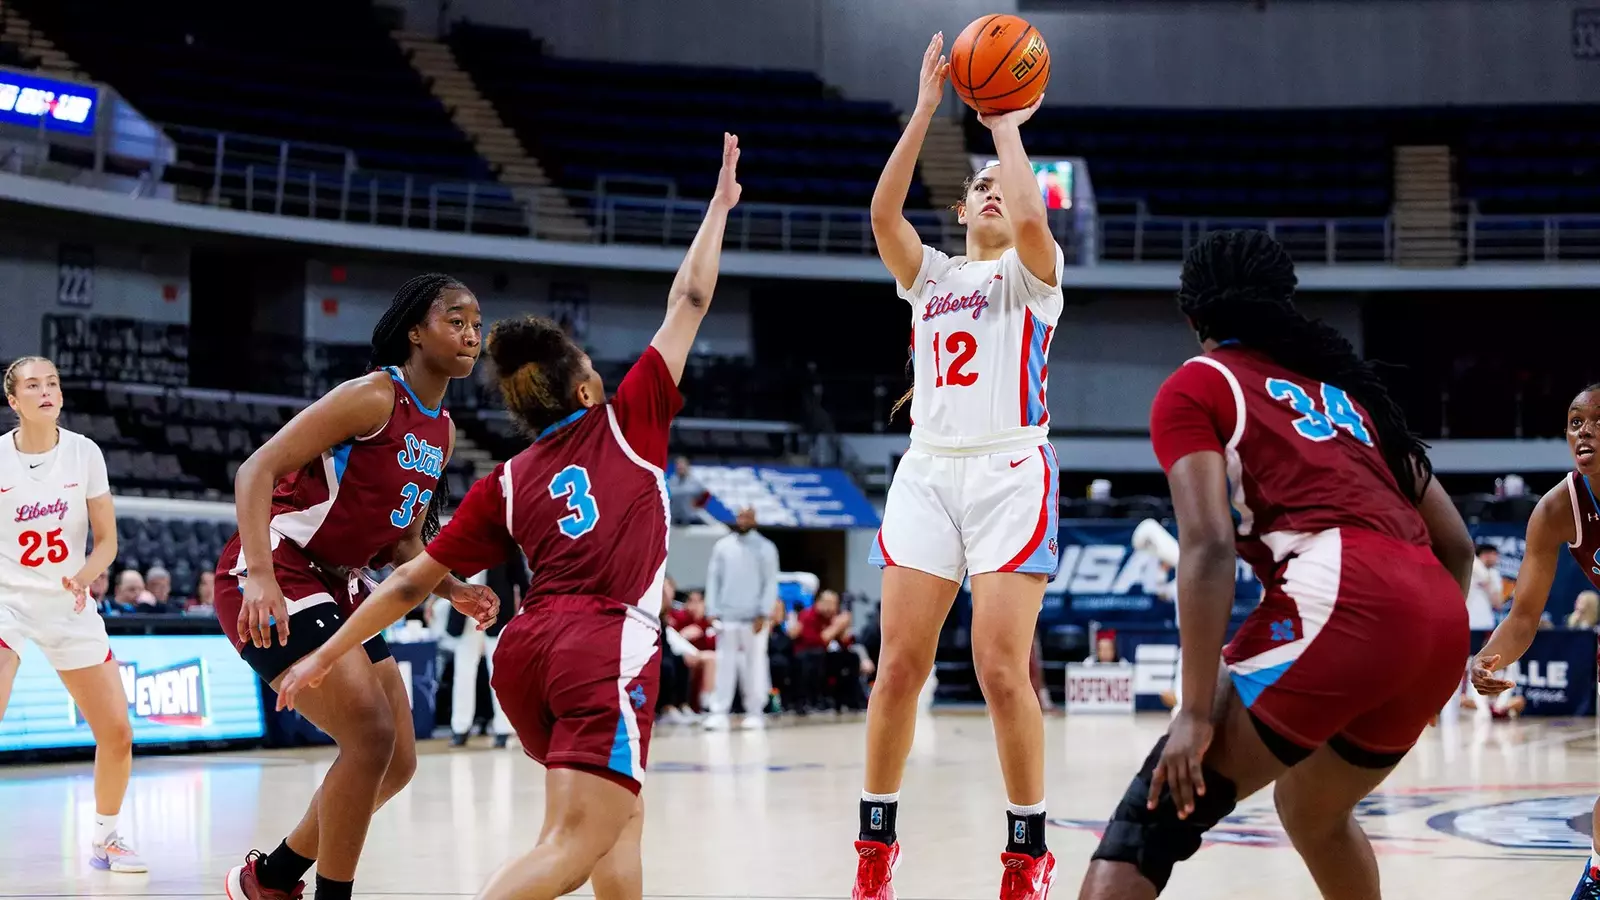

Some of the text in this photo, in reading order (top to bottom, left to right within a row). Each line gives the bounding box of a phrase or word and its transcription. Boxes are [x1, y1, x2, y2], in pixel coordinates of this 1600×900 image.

[1010, 36, 1045, 82] ELITE
[922, 290, 989, 321] Liberty
[933, 331, 979, 388] 12
[1265, 377, 1374, 447] 34
[14, 498, 68, 522] Liberty
[548, 464, 600, 539] 3
[18, 527, 69, 567] 25
[136, 665, 200, 716] EVENT
[1067, 677, 1130, 703] DEFENSE
